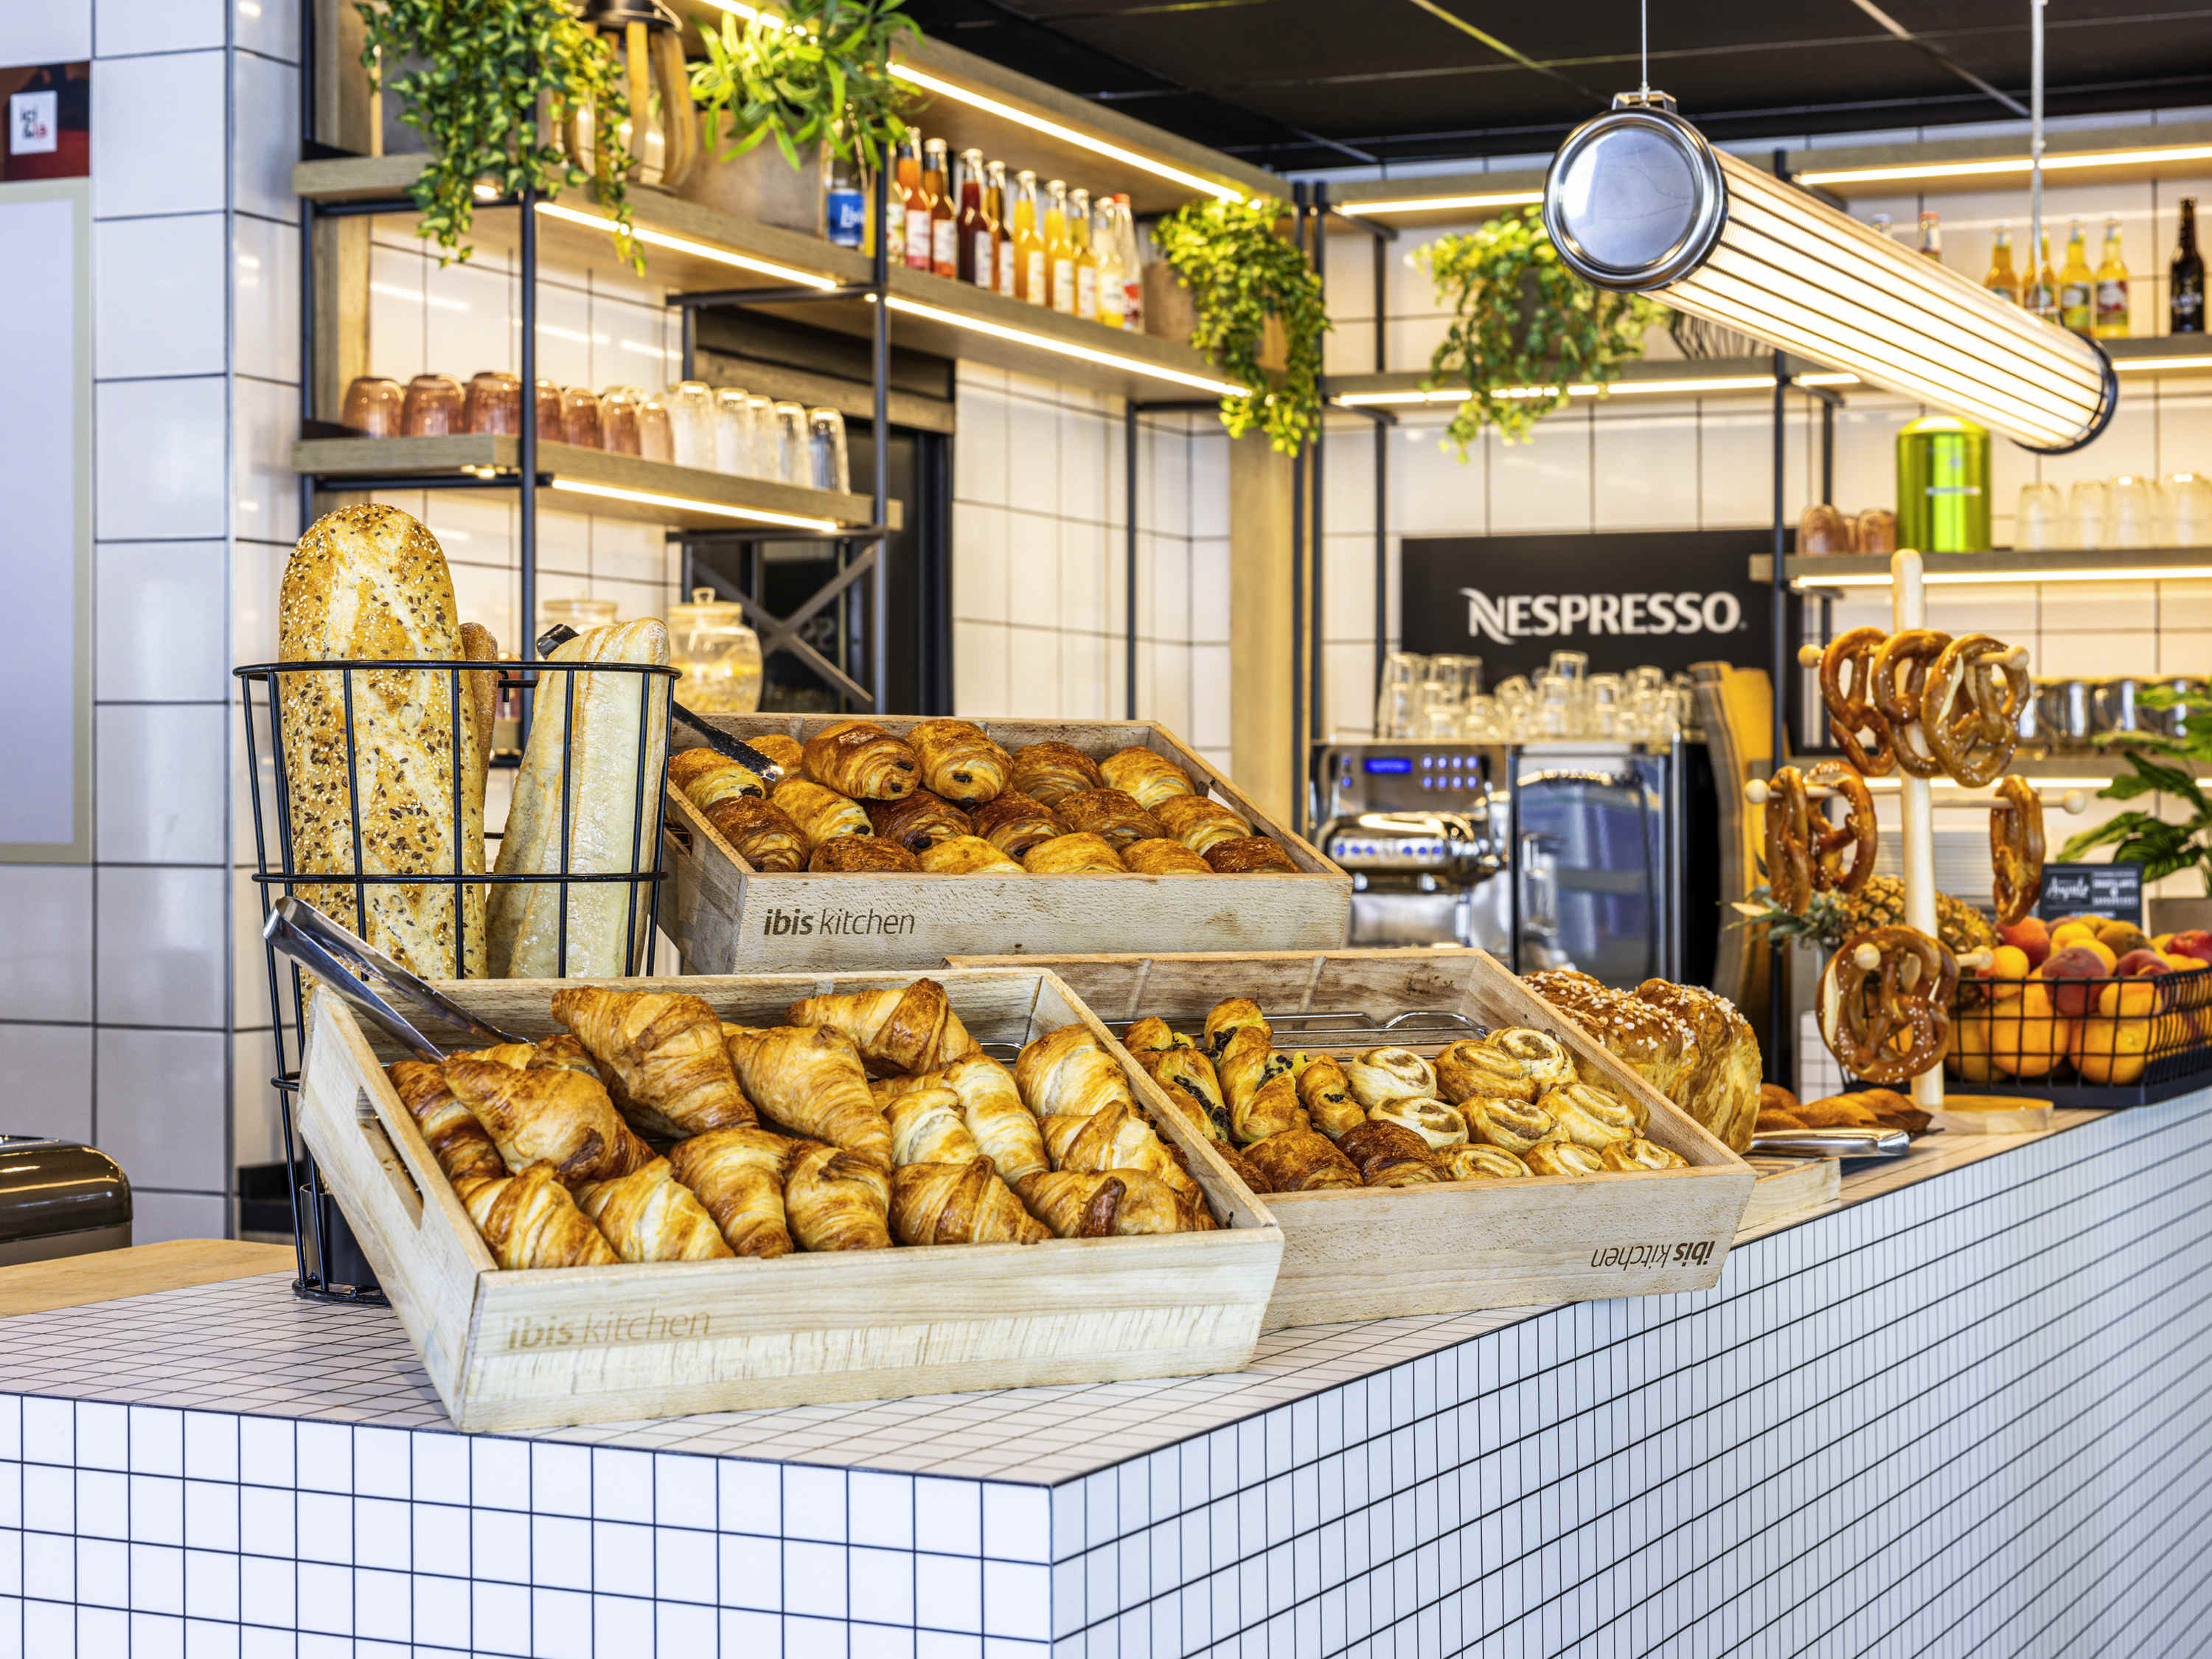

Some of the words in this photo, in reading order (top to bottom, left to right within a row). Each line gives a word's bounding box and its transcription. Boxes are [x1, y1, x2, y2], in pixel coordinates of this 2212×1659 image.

[1458, 588, 1742, 644] NESPRESSO
[763, 908, 814, 935] ibis
[819, 908, 916, 935] kitchen
[1590, 1244, 1672, 1271] kitchen
[1672, 1240, 1716, 1267] ibis
[508, 1315, 574, 1349] ibis
[582, 1307, 712, 1345] kitchen
